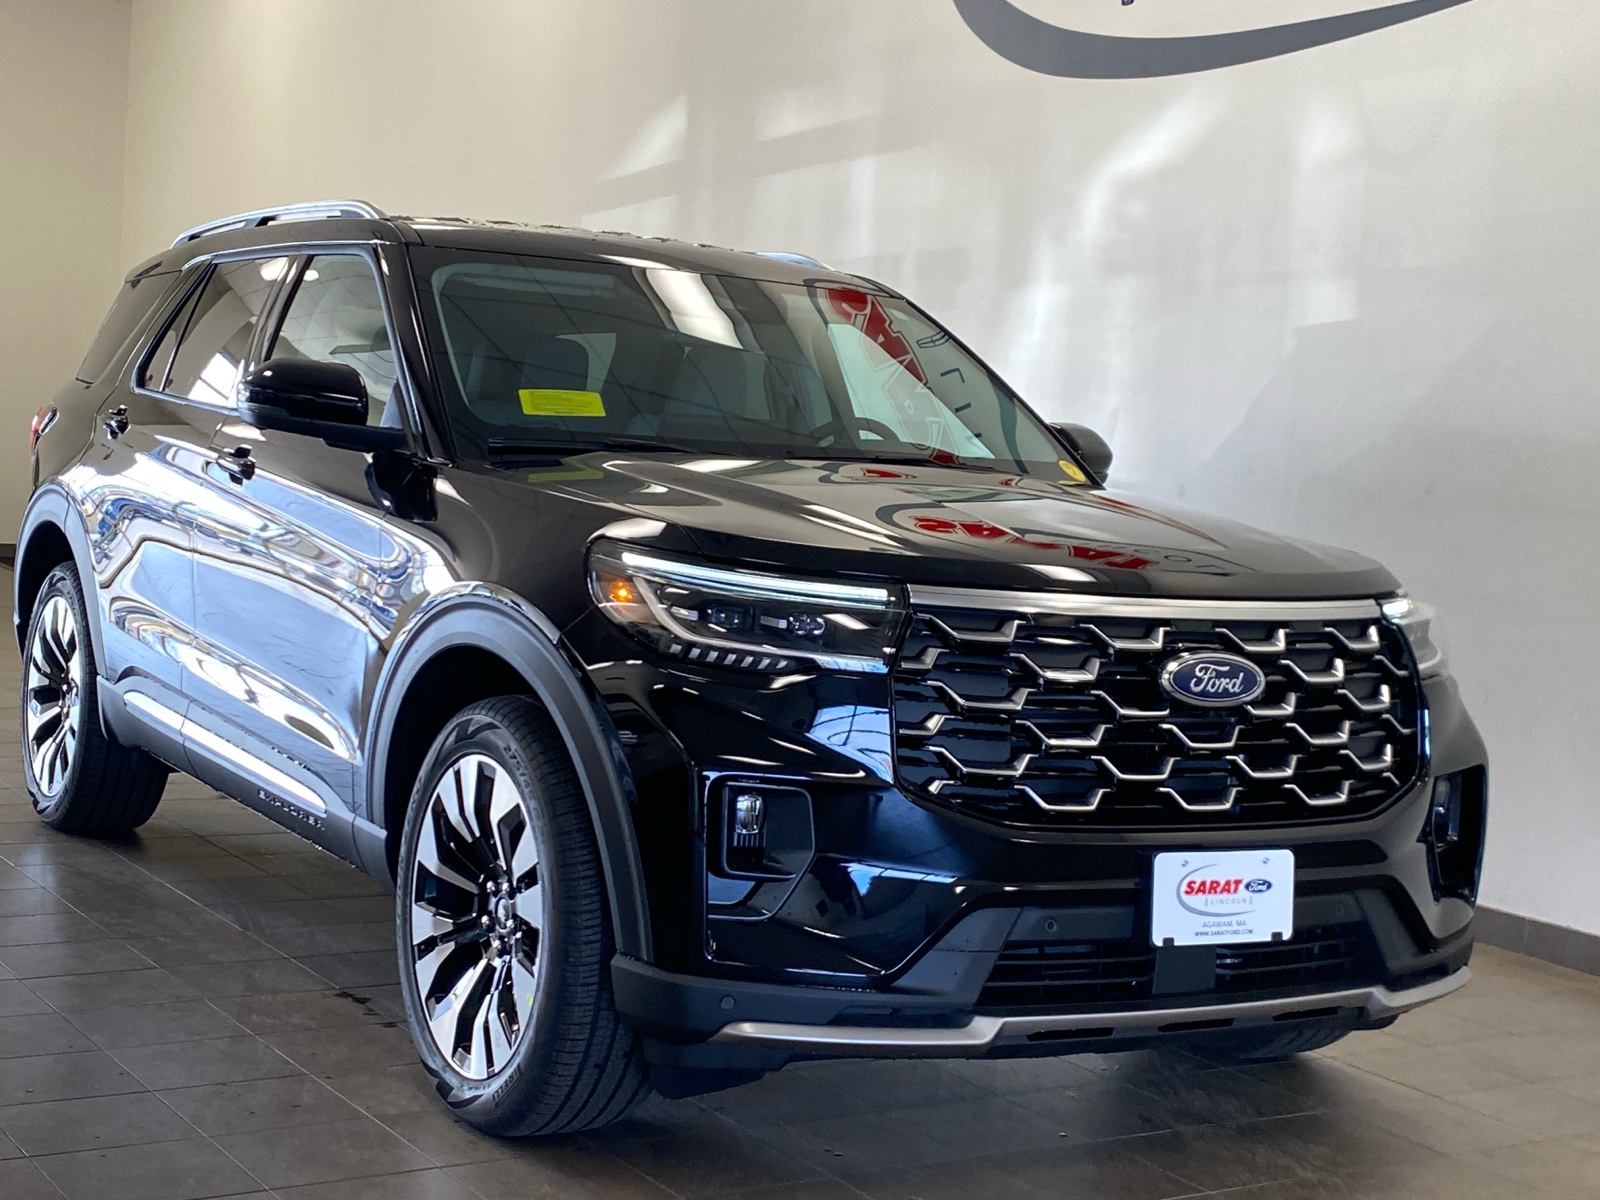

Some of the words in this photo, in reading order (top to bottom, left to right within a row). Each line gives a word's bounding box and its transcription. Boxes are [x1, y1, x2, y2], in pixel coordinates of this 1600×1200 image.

[1190, 663, 1245, 693] Ford
[1184, 878, 1243, 895] SARAT
[1249, 880, 1269, 892] Ford
[1202, 920, 1234, 928] AGAWAM,
